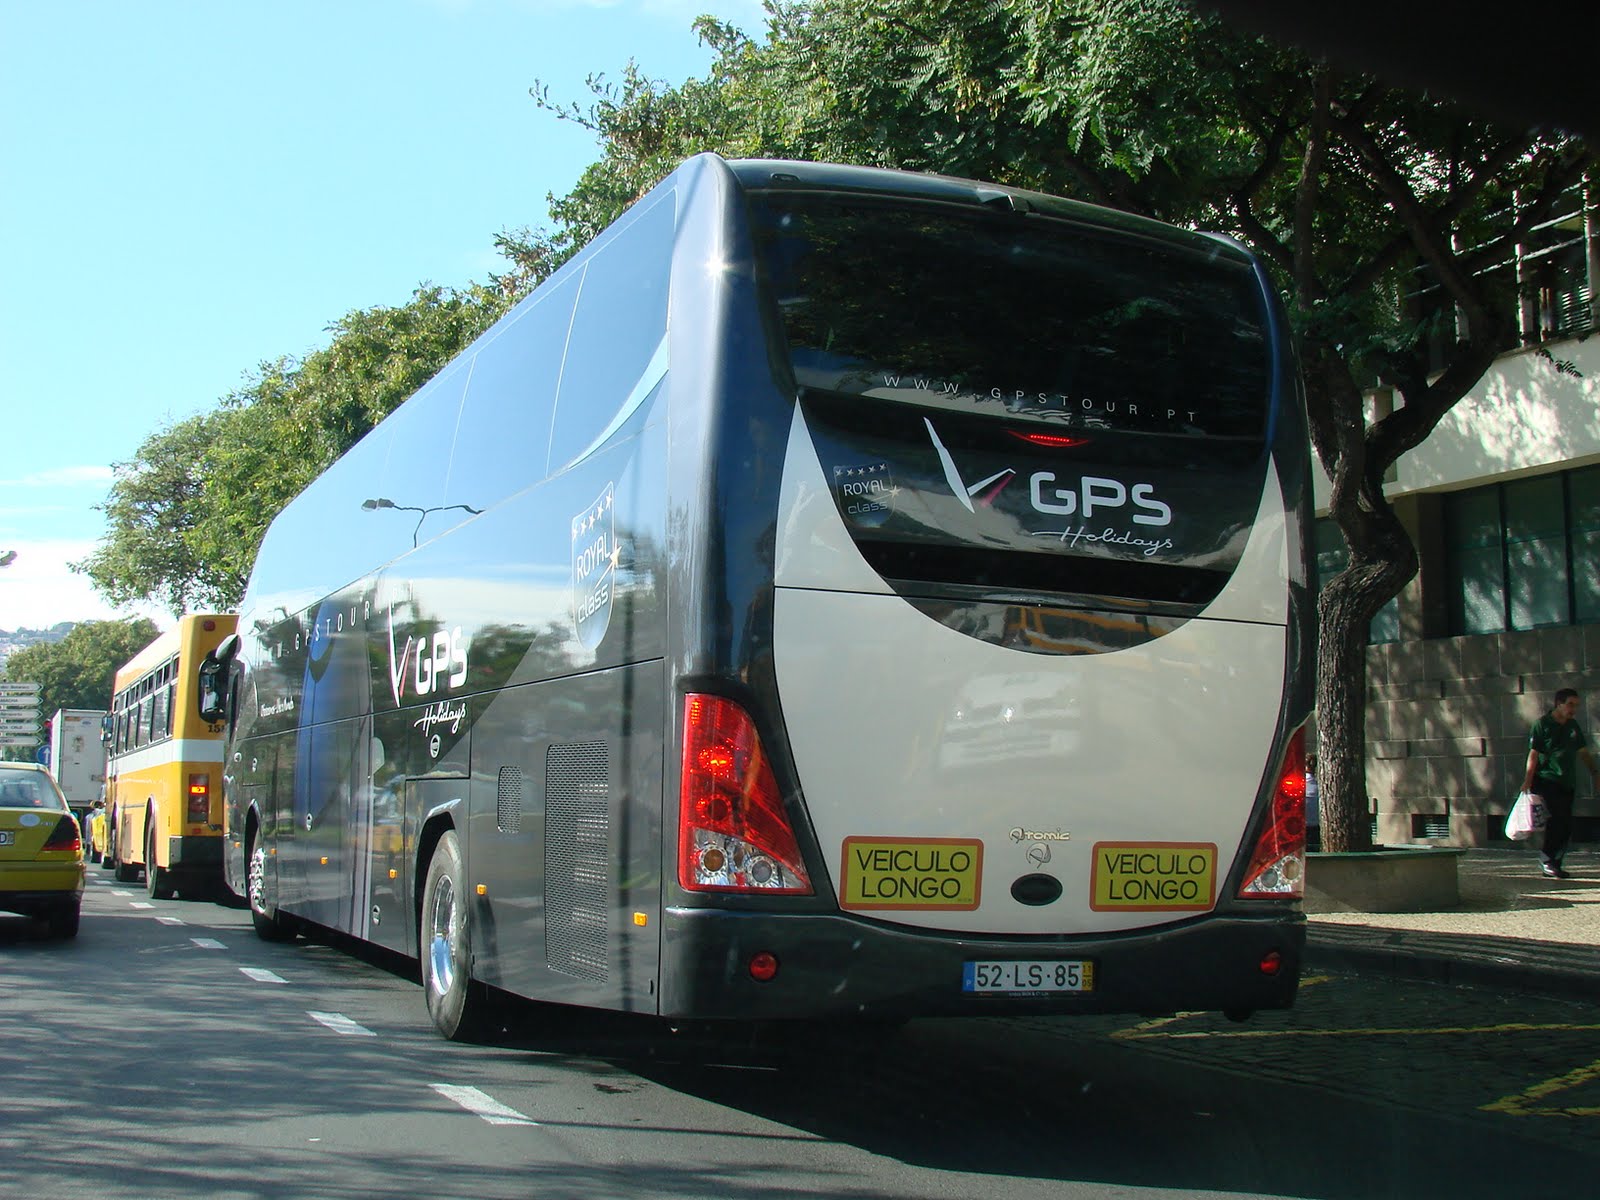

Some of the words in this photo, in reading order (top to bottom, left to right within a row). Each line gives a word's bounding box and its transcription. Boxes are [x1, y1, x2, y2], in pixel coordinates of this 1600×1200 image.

[843, 479, 889, 497] ROYAL
[1030, 471, 1172, 527] GPS
[847, 501, 888, 515] class
[1031, 526, 1173, 556] Holidays
[576, 531, 611, 584] ROYAL
[577, 583, 609, 624] class
[415, 625, 468, 696] GPS
[413, 701, 467, 738] Holidays
[856, 848, 970, 873] VEICULO
[1104, 853, 1206, 875] VEICULO
[861, 876, 961, 899] LONGO
[1108, 879, 1199, 900] LONGO
